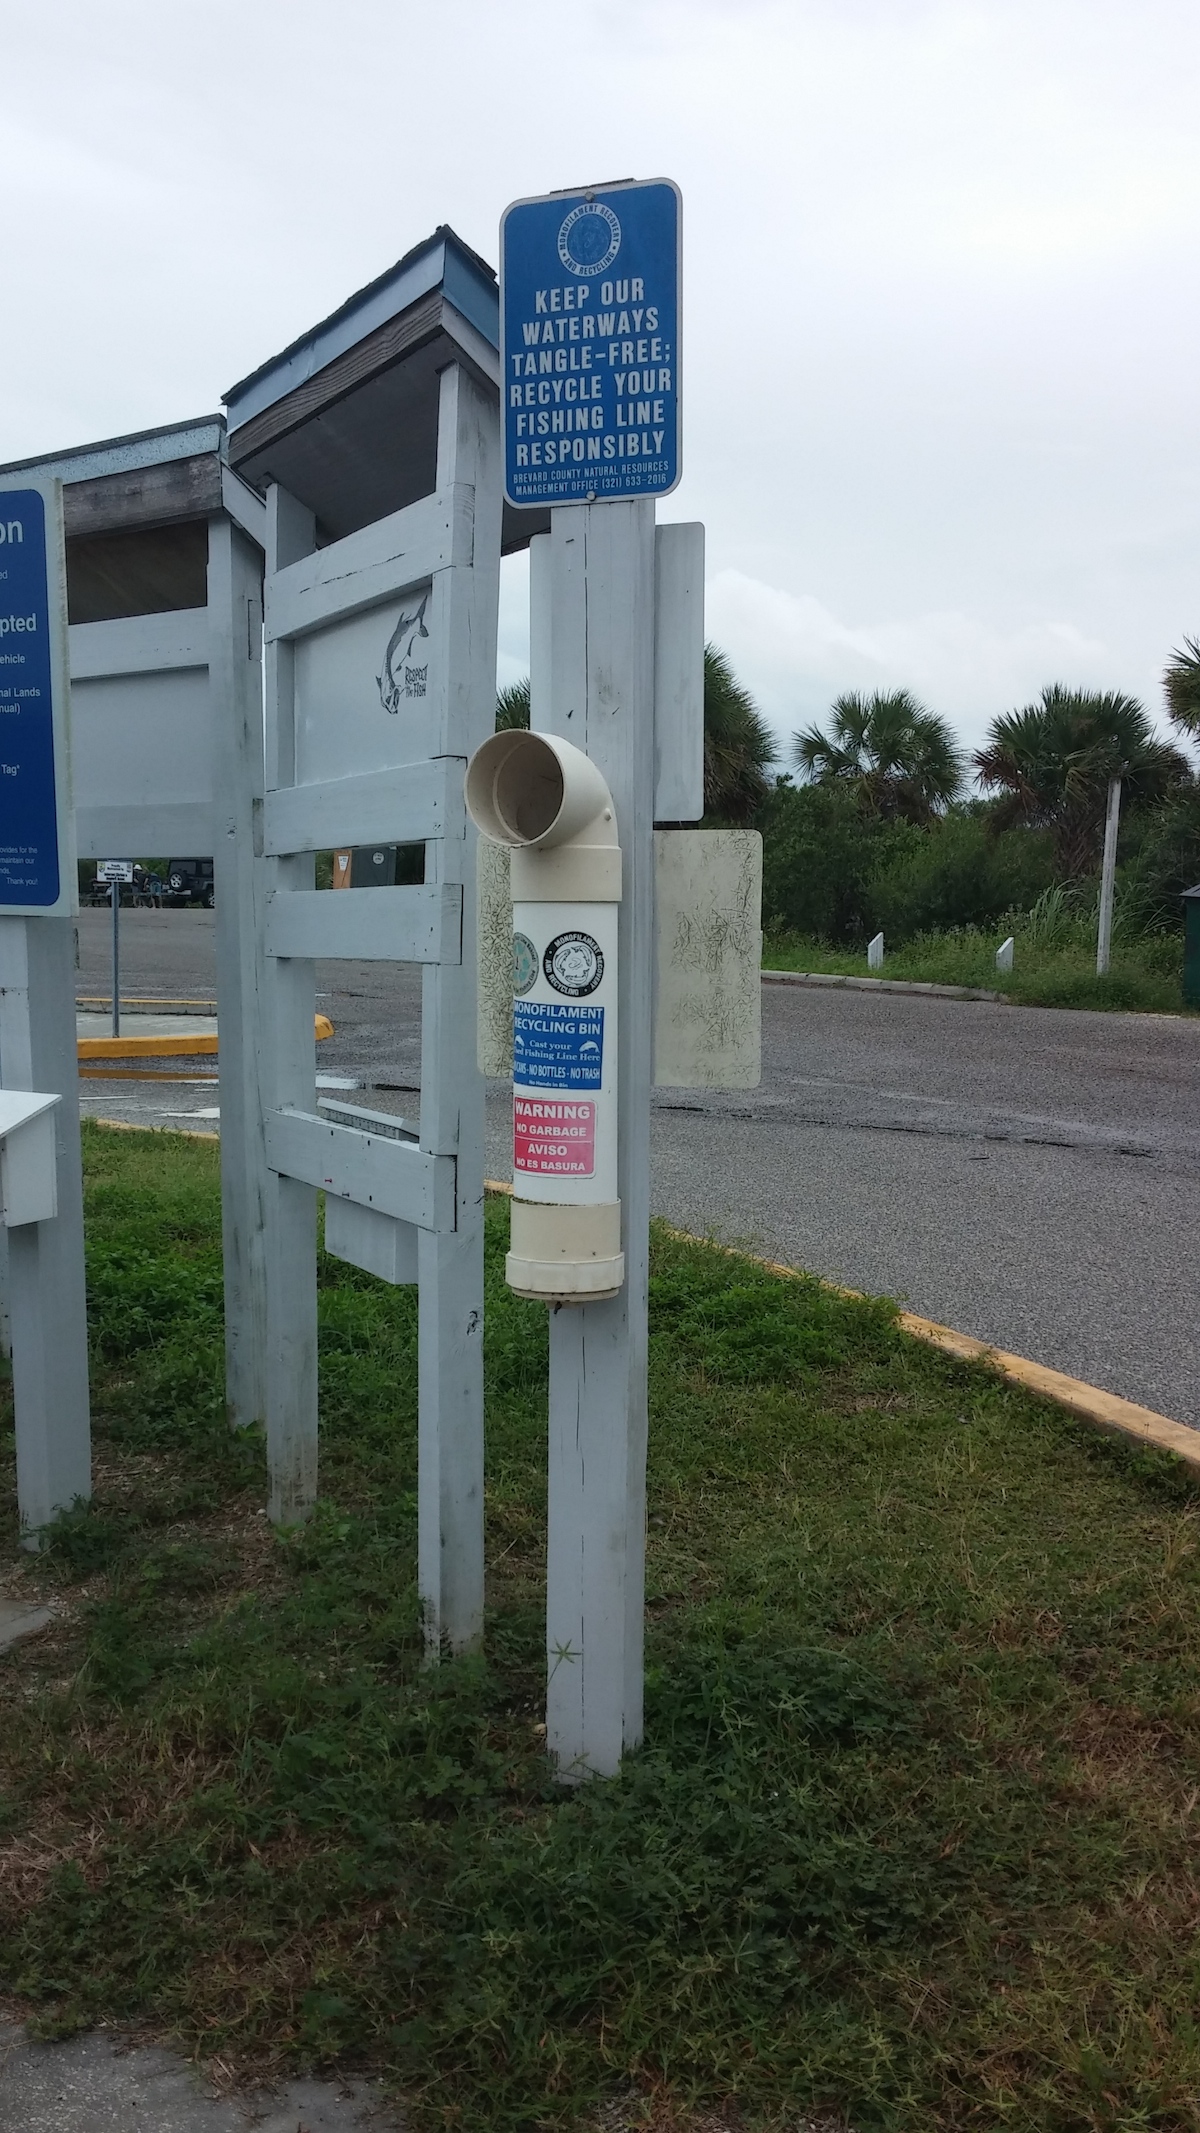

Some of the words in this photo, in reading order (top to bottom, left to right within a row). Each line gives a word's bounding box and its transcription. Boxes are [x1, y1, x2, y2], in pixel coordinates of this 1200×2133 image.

[559, 204, 598, 250] MONOFILAMENT
[600, 206, 619, 243] RECOVERY
[564, 257, 577, 272] AND
[578, 251, 615, 275] RECYCLING
[535, 285, 590, 314] KEEP
[601, 277, 644, 306] OUR
[522, 306, 659, 346] WATERWAYS
[511, 337, 671, 377] TANGLE-FREE;
[510, 375, 603, 408] RECYCLE
[614, 368, 672, 396] YOUR
[516, 405, 604, 437] FISHING
[616, 399, 665, 427] LINE
[516, 430, 665, 467] RESPONSIBLY
[513, 471, 548, 484] BREVARD
[550, 468, 581, 481] COUNTY
[584, 465, 618, 478] NATURAL
[621, 460, 669, 475] RESOURCES
[515, 481, 569, 496] MANAGEMENT
[571, 479, 598, 492] OFFICE
[602, 477, 622, 489] (321)
[625, 473, 667, 487] 633-2016
[0, 612, 37, 638] pted
[13, 686, 41, 698] Lands
[544, 959, 553, 973] AND
[554, 932, 601, 954] MONOFILAMENT
[591, 954, 603, 990] RECOVERY
[547, 973, 580, 996] RECYCLING
[578, 1022, 601, 1035] BIN
[525, 1049, 555, 1060] Fishing
[556, 1052, 578, 1061] Line
[580, 1053, 601, 1062] Here
[529, 1039, 548, 1048] Cast
[549, 1043, 572, 1051] your
[528, 1064, 538, 1076] NO
[538, 1065, 566, 1079] BOTTLES
[570, 1067, 581, 1080] NO
[581, 1067, 601, 1080] TRASH
[515, 1101, 590, 1119] WARNING
[516, 1122, 527, 1133] NO
[529, 1124, 587, 1137] GARBAGE
[527, 1143, 568, 1156] AVISO
[516, 1157, 525, 1167] NO
[526, 1159, 538, 1169] ES
[540, 1160, 586, 1171] BASURA
